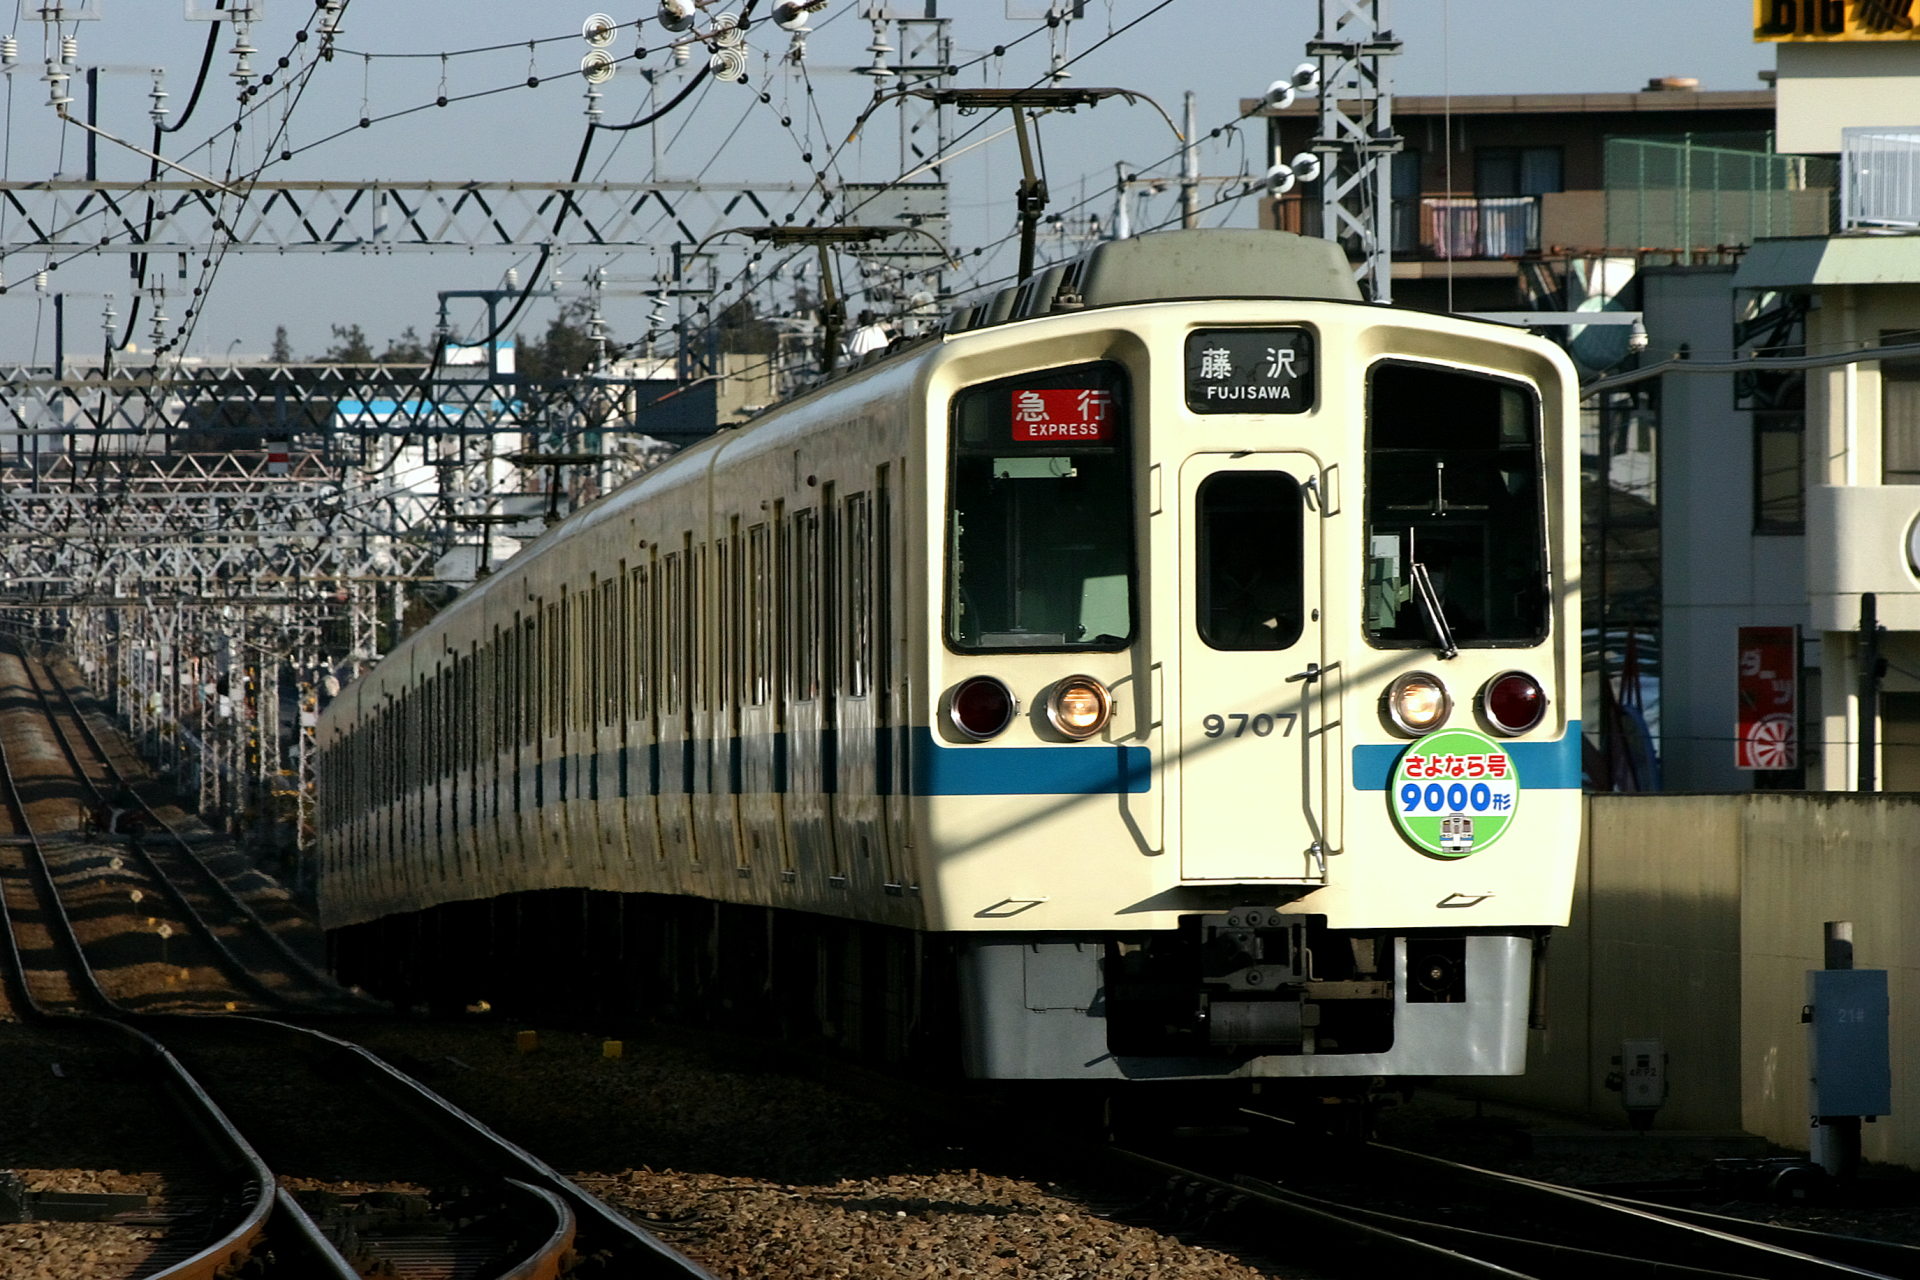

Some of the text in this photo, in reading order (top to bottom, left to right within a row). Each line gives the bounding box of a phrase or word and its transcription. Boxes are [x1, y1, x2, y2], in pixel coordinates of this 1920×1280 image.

[1207, 386, 1291, 399] FUJISAWA
[1029, 423, 1098, 436] EXPRESS
[1203, 713, 1298, 738] 9707
[1405, 755, 1507, 777] さよなら号
